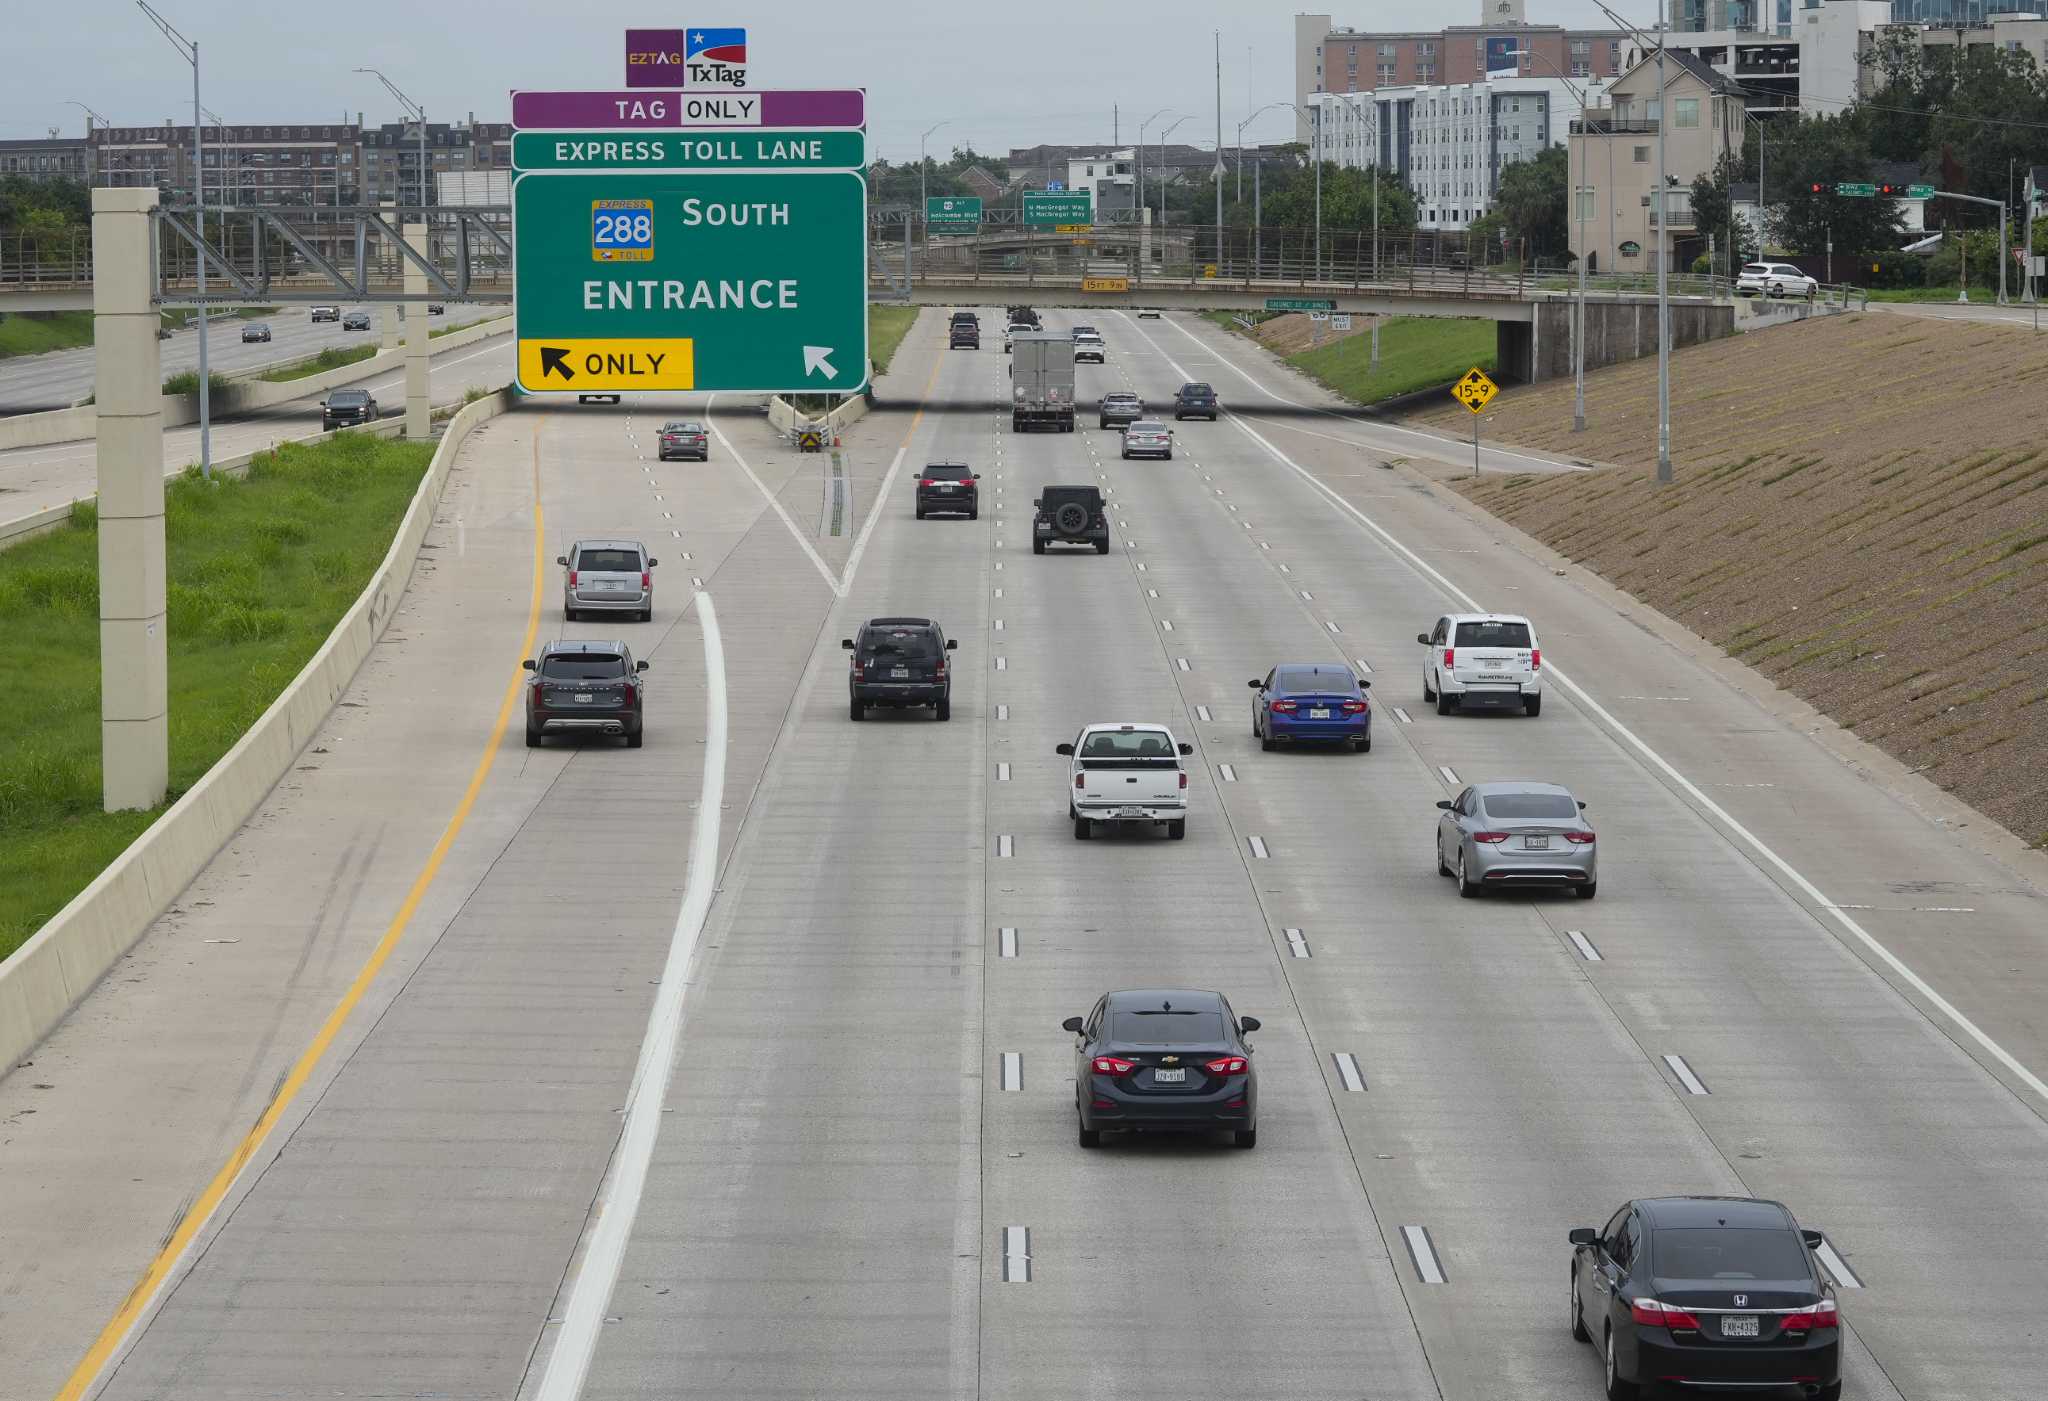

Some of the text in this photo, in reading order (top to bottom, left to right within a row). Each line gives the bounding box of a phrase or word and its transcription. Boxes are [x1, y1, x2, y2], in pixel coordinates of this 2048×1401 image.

[687, 64, 746, 88] TxTag
[615, 100, 754, 120] TAG ONLY
[555, 140, 823, 161] EXPRESS TOLL LANE
[599, 200, 647, 209] EXPRESS
[682, 198, 790, 226] SOUTH
[595, 215, 651, 243] 288
[583, 279, 799, 310] ENTRANCE
[585, 353, 667, 375] ONLY
